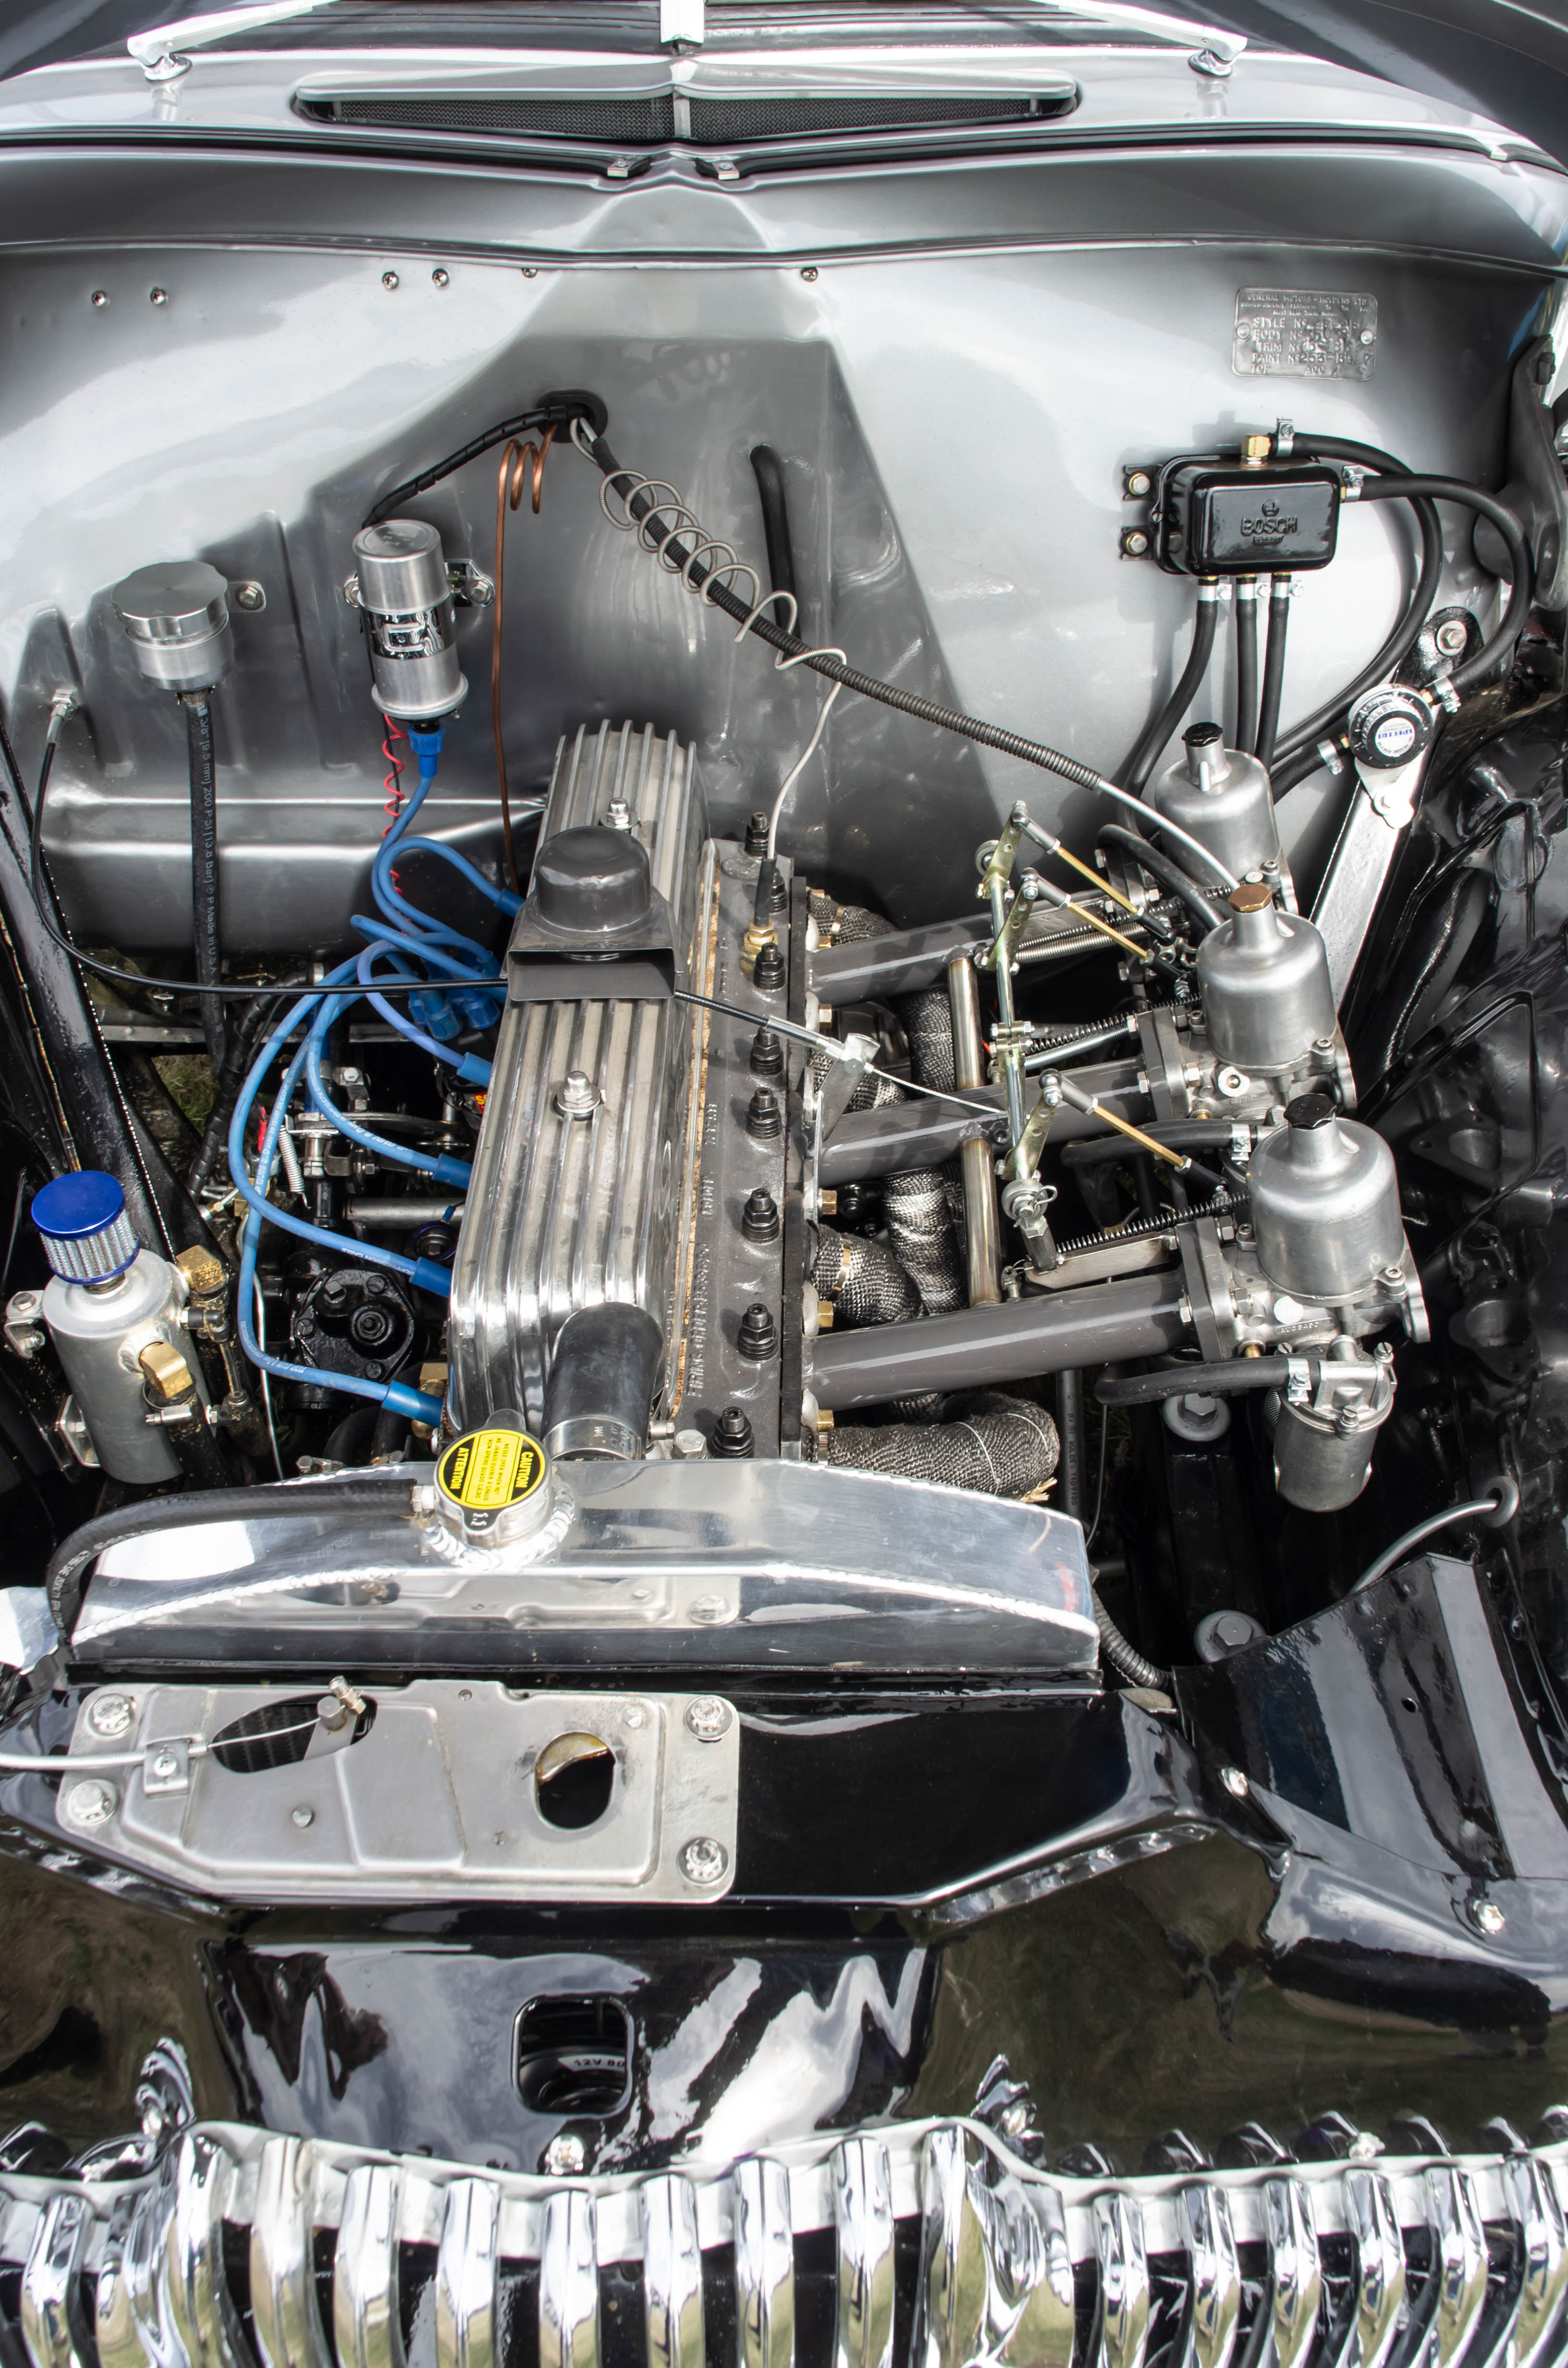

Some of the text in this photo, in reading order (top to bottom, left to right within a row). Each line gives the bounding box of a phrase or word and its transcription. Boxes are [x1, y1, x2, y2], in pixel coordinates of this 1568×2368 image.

[1253, 318, 1285, 328] STYLE
[1253, 329, 1283, 340] BODY
[1256, 342, 1282, 352] TRIM
[1252, 352, 1281, 363] PAINT
[1250, 364, 1269, 374] TOP
[1240, 516, 1298, 535] BOSCH
[203, 787, 212, 806] 200
[206, 907, 216, 934] Made
[256, 1165, 266, 1185] GUN
[342, 1247, 363, 1258] CABLE
[289, 1365, 307, 1374] TOP
[492, 1444, 500, 1461] JAMAIS
[450, 1447, 469, 1489] ATTENTION
[489, 1462, 497, 1480] OUVRIR
[515, 1451, 534, 1488] CAUTION
[574, 2058, 602, 2066] 12V
